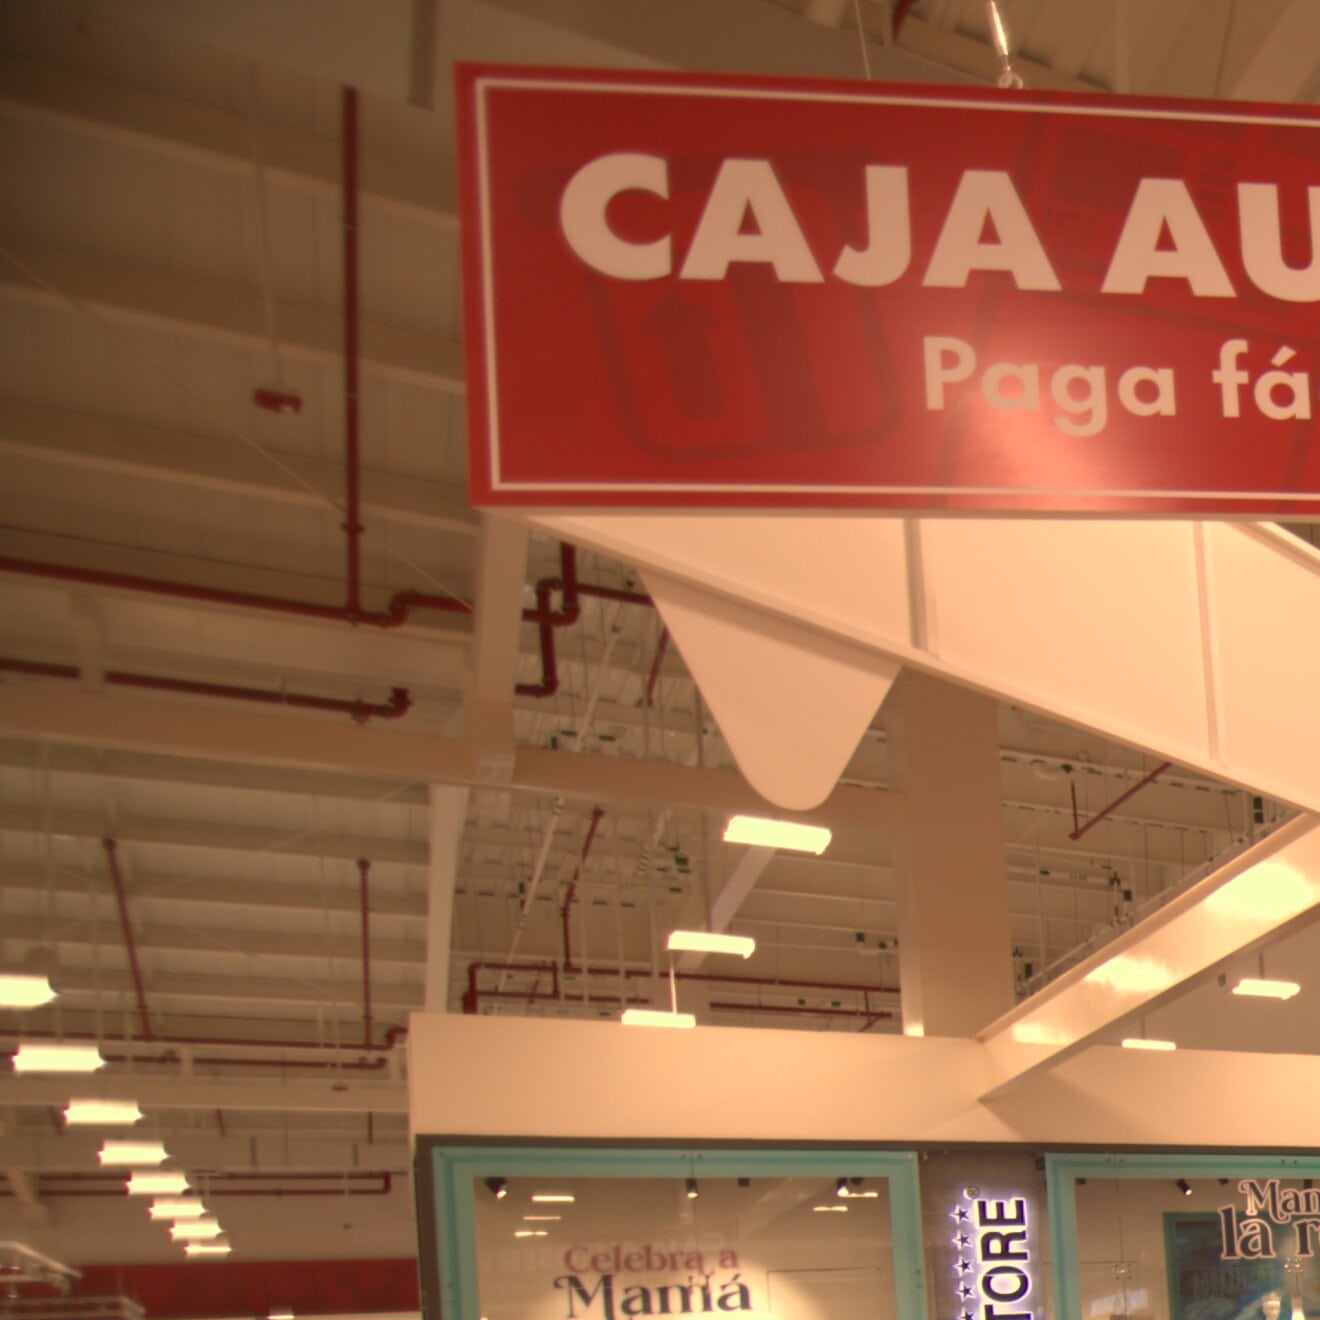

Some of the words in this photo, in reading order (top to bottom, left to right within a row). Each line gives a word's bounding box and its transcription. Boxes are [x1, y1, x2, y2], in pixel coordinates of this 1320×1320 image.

[560, 152, 1063, 292] CAJA
[922, 335, 1176, 437] Paga
[563, 1243, 712, 1274] Celebra
[719, 1247, 741, 1269] a
[1218, 1205, 1277, 1260] la
